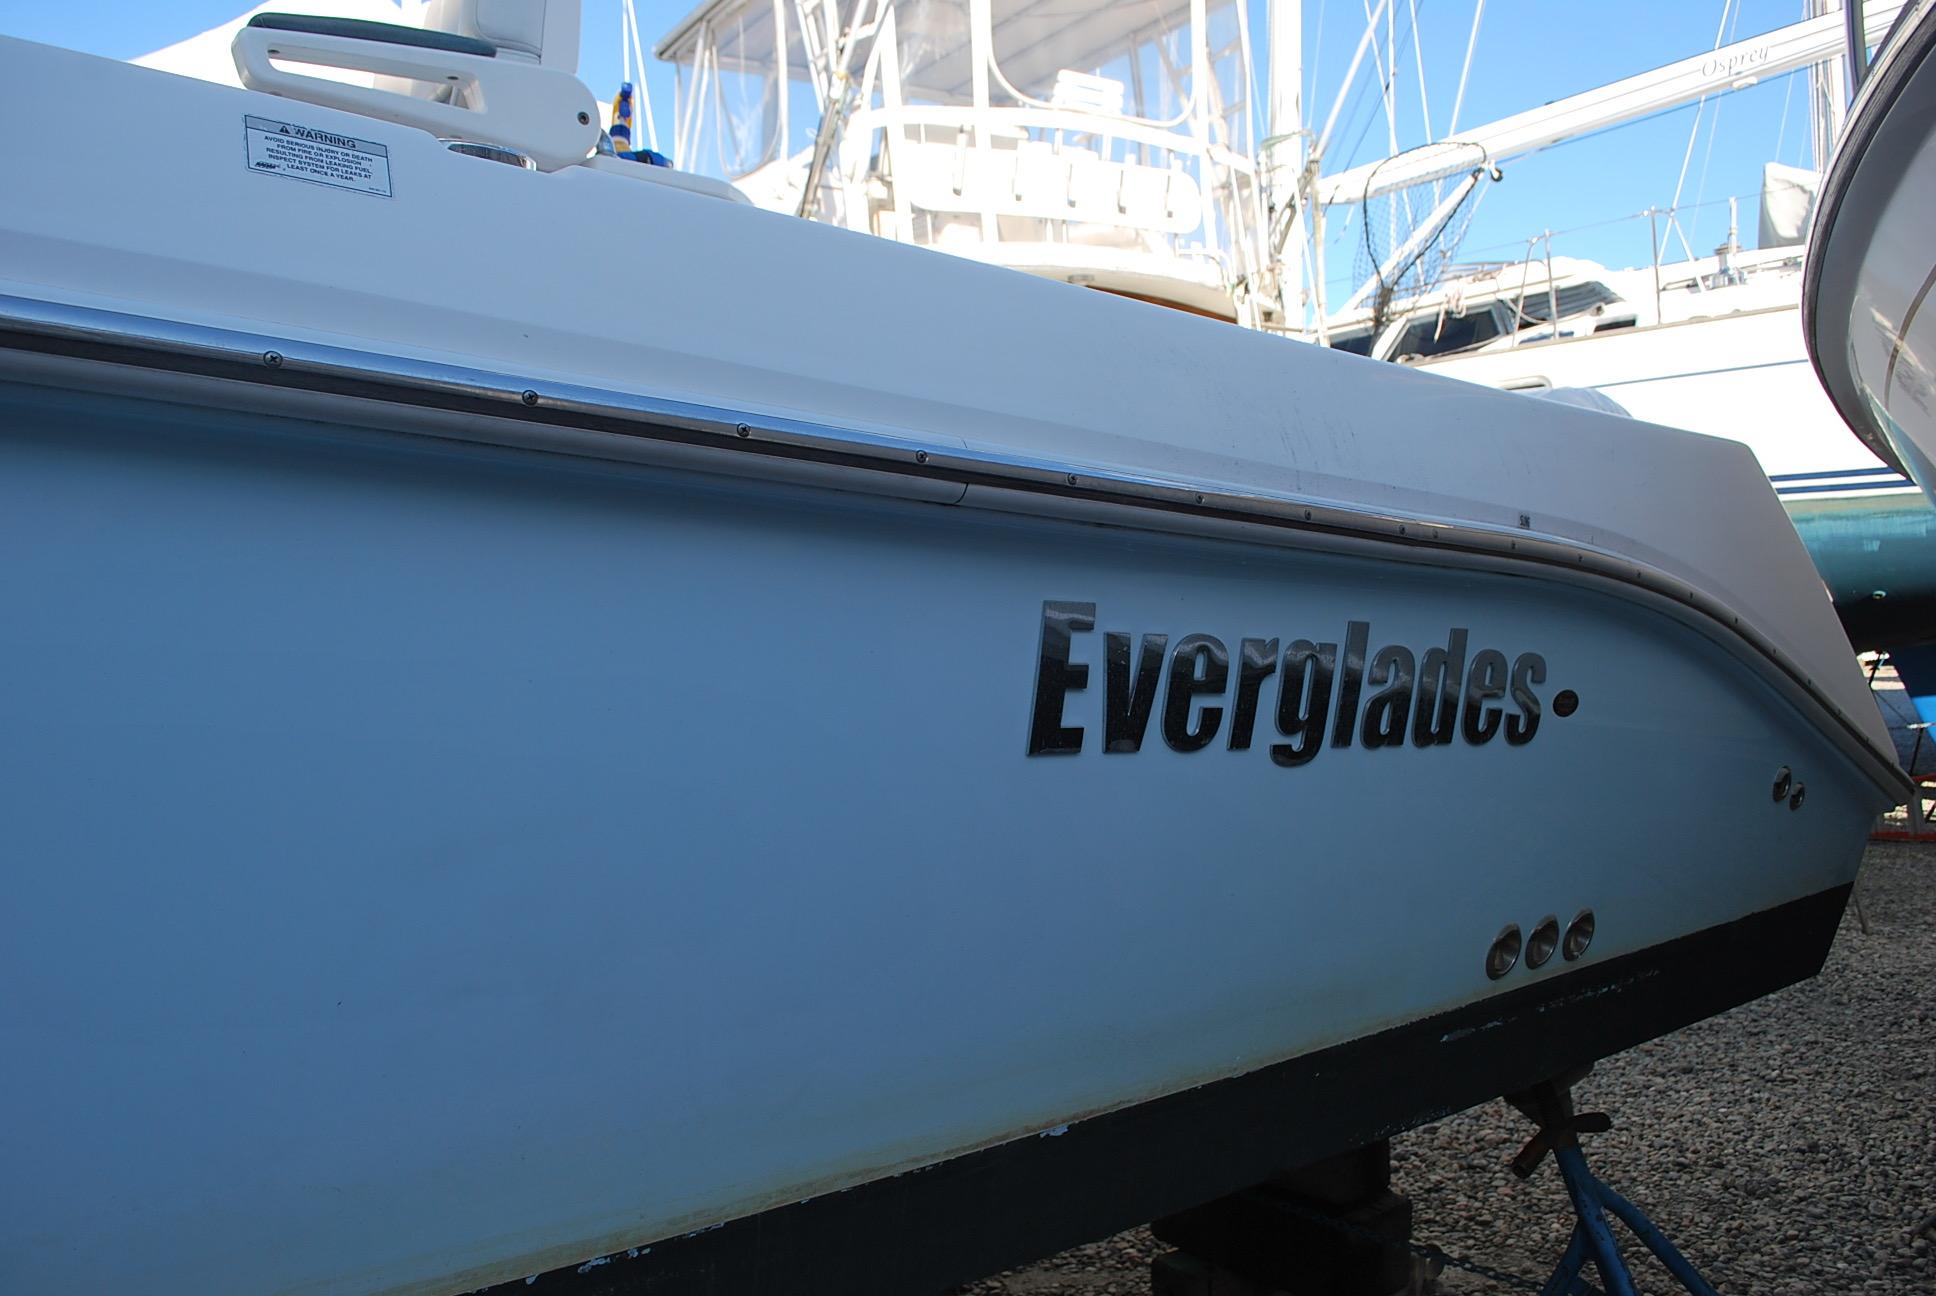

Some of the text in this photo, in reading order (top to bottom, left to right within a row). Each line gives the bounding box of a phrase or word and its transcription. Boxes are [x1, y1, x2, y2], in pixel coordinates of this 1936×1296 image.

[1702, 46, 1768, 77] Osprey
[264, 135, 285, 144] AVOID
[286, 139, 315, 151] SERIOUS
[316, 145, 340, 156] INJURY
[352, 154, 373, 163] DEATH
[294, 128, 356, 149] WARNING
[266, 147, 303, 160] RESULTING
[304, 155, 324, 164] FROM
[325, 159, 353, 170] LEAKING
[268, 154, 297, 164] INSPECT
[298, 160, 326, 170] SYSTEM
[326, 165, 340, 173] FOR
[341, 169, 363, 178] LEAKS
[276, 144, 297, 152] FROM
[297, 148, 313, 156] FIRE
[325, 153, 362, 166] EXPLOSION
[287, 163, 308, 172] LEAST
[309, 168, 329, 177] ONCE
[1026, 600, 1548, 768] Everglades
